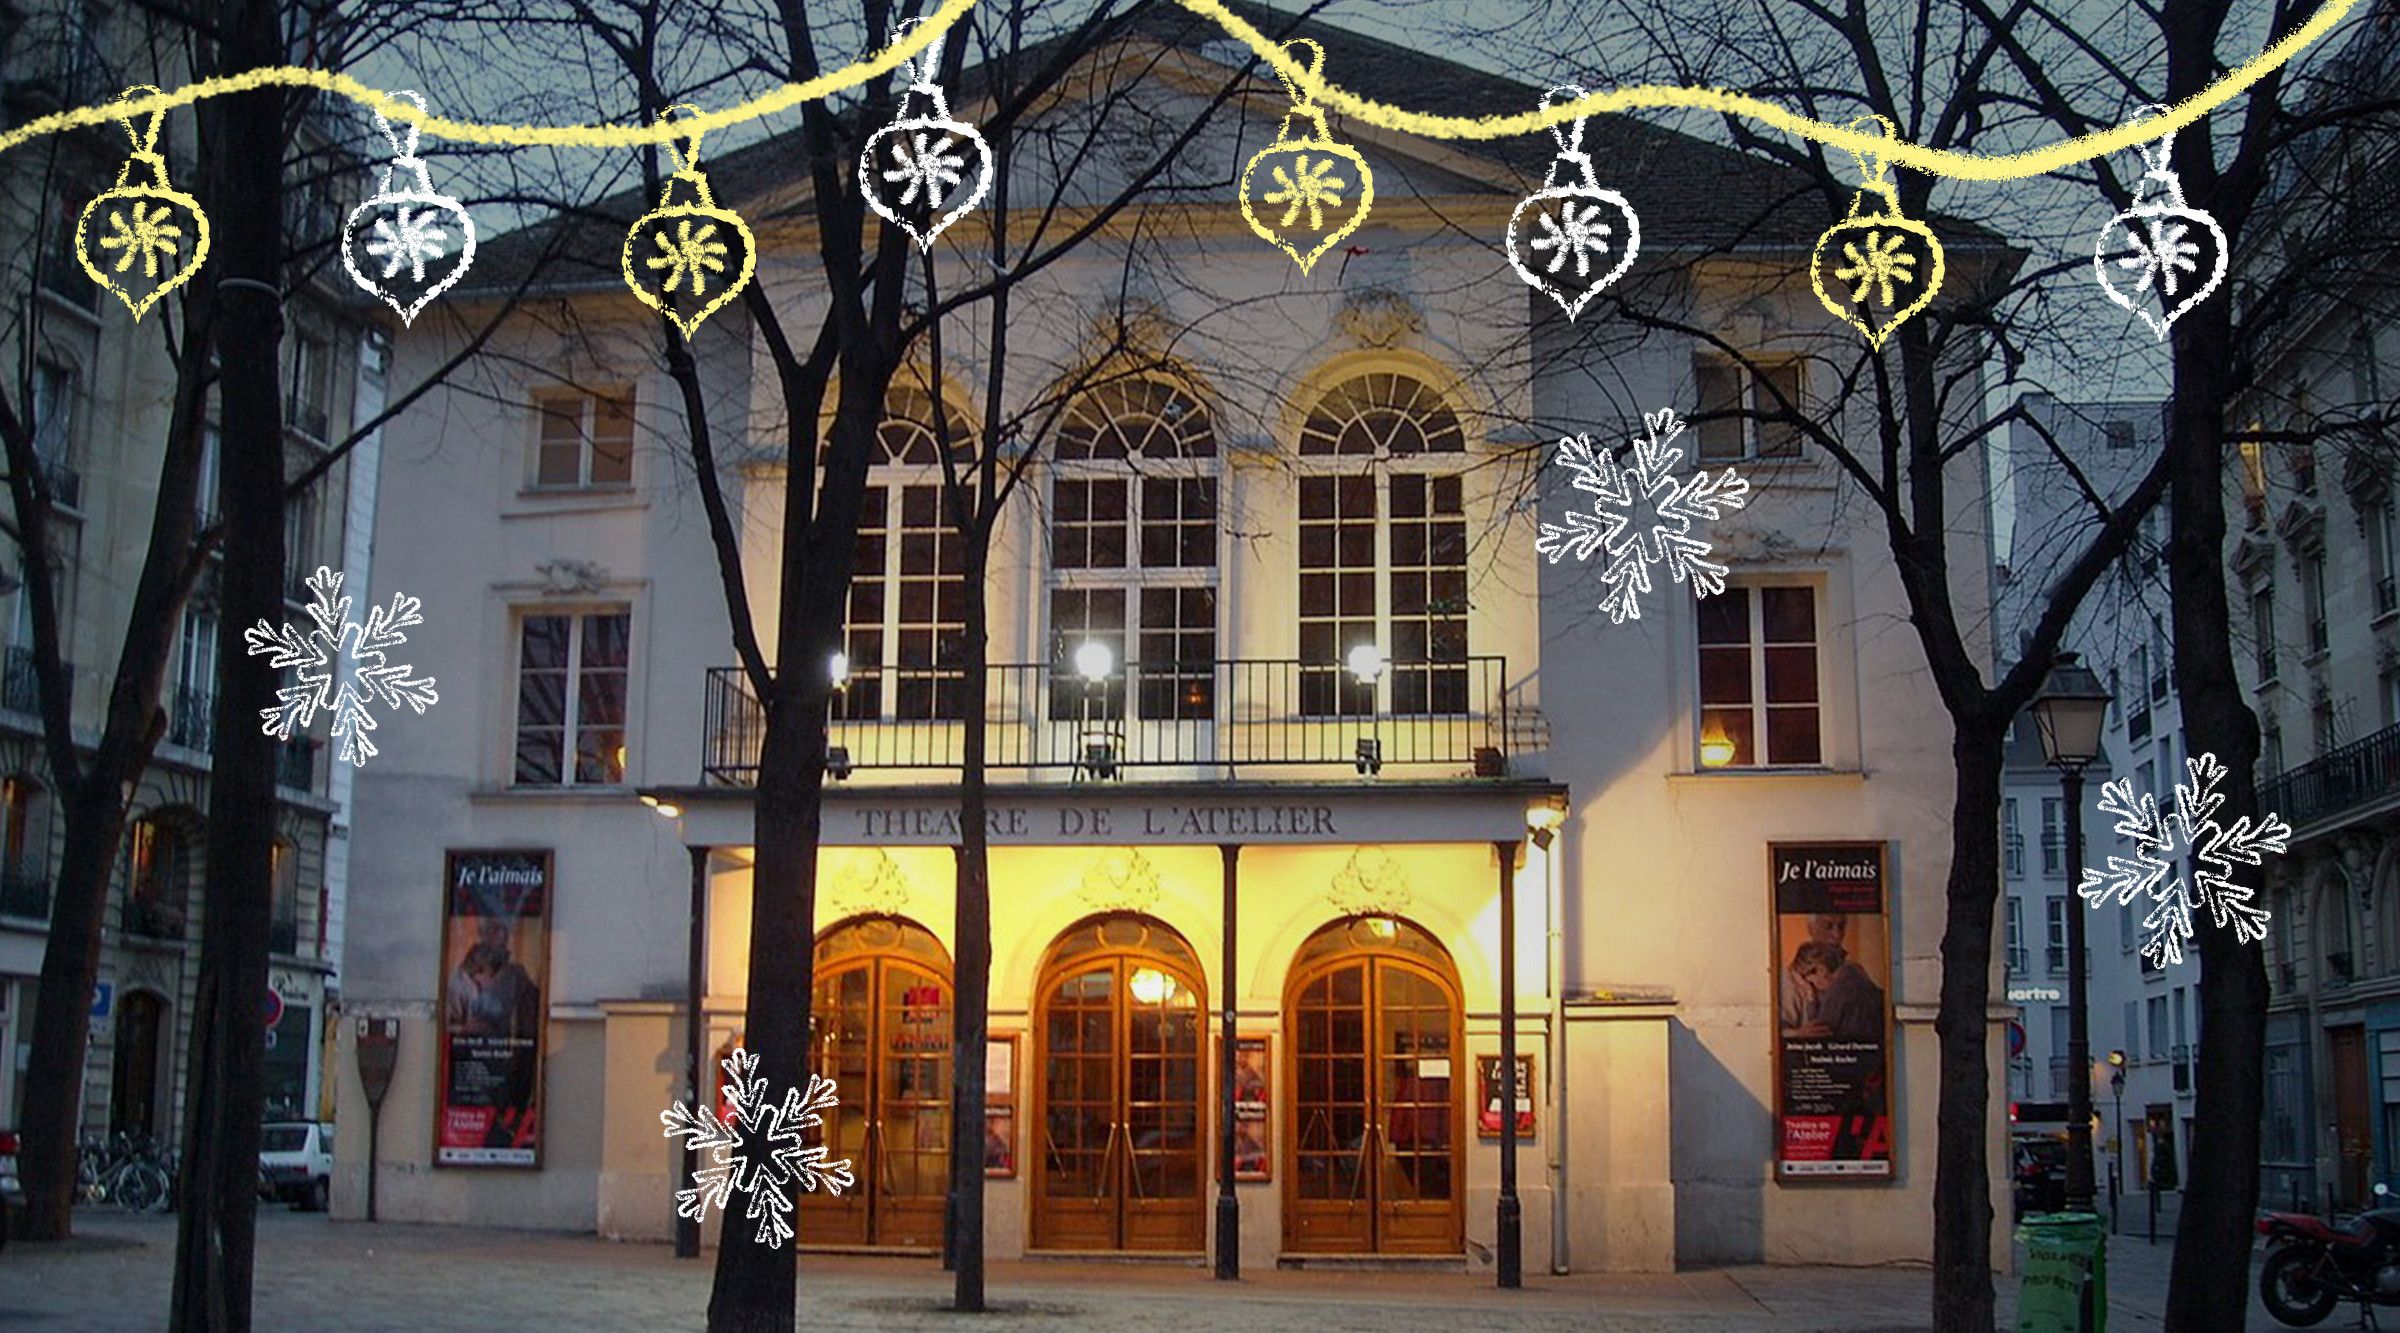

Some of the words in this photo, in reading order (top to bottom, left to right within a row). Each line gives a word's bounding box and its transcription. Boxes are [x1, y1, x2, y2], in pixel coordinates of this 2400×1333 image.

[856, 807, 1029, 837] THEARE
[1057, 807, 1112, 836] DE
[1143, 806, 1338, 836] L'ATELIER
[459, 866, 477, 887] Je
[479, 865, 543, 885] l'aimais
[1779, 861, 1801, 884] Je
[1804, 860, 1877, 879] l'aimais
